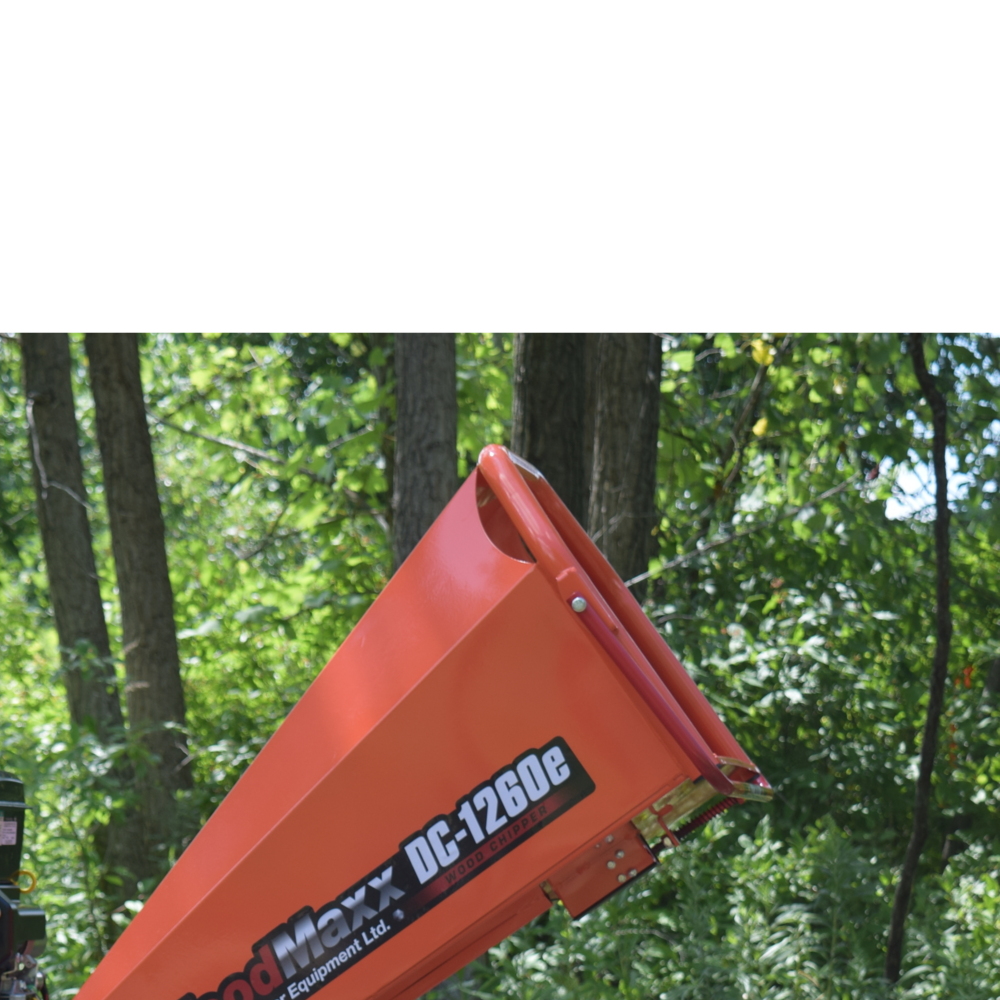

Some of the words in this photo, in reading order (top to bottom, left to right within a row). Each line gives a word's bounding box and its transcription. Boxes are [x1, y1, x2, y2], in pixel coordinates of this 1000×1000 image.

[404, 746, 571, 885] DC-1260e
[445, 851, 485, 884] WOOD
[489, 804, 549, 852] CHIPPER
[286, 938, 363, 1000] Equipment
[361, 918, 392, 946] Ltd.
